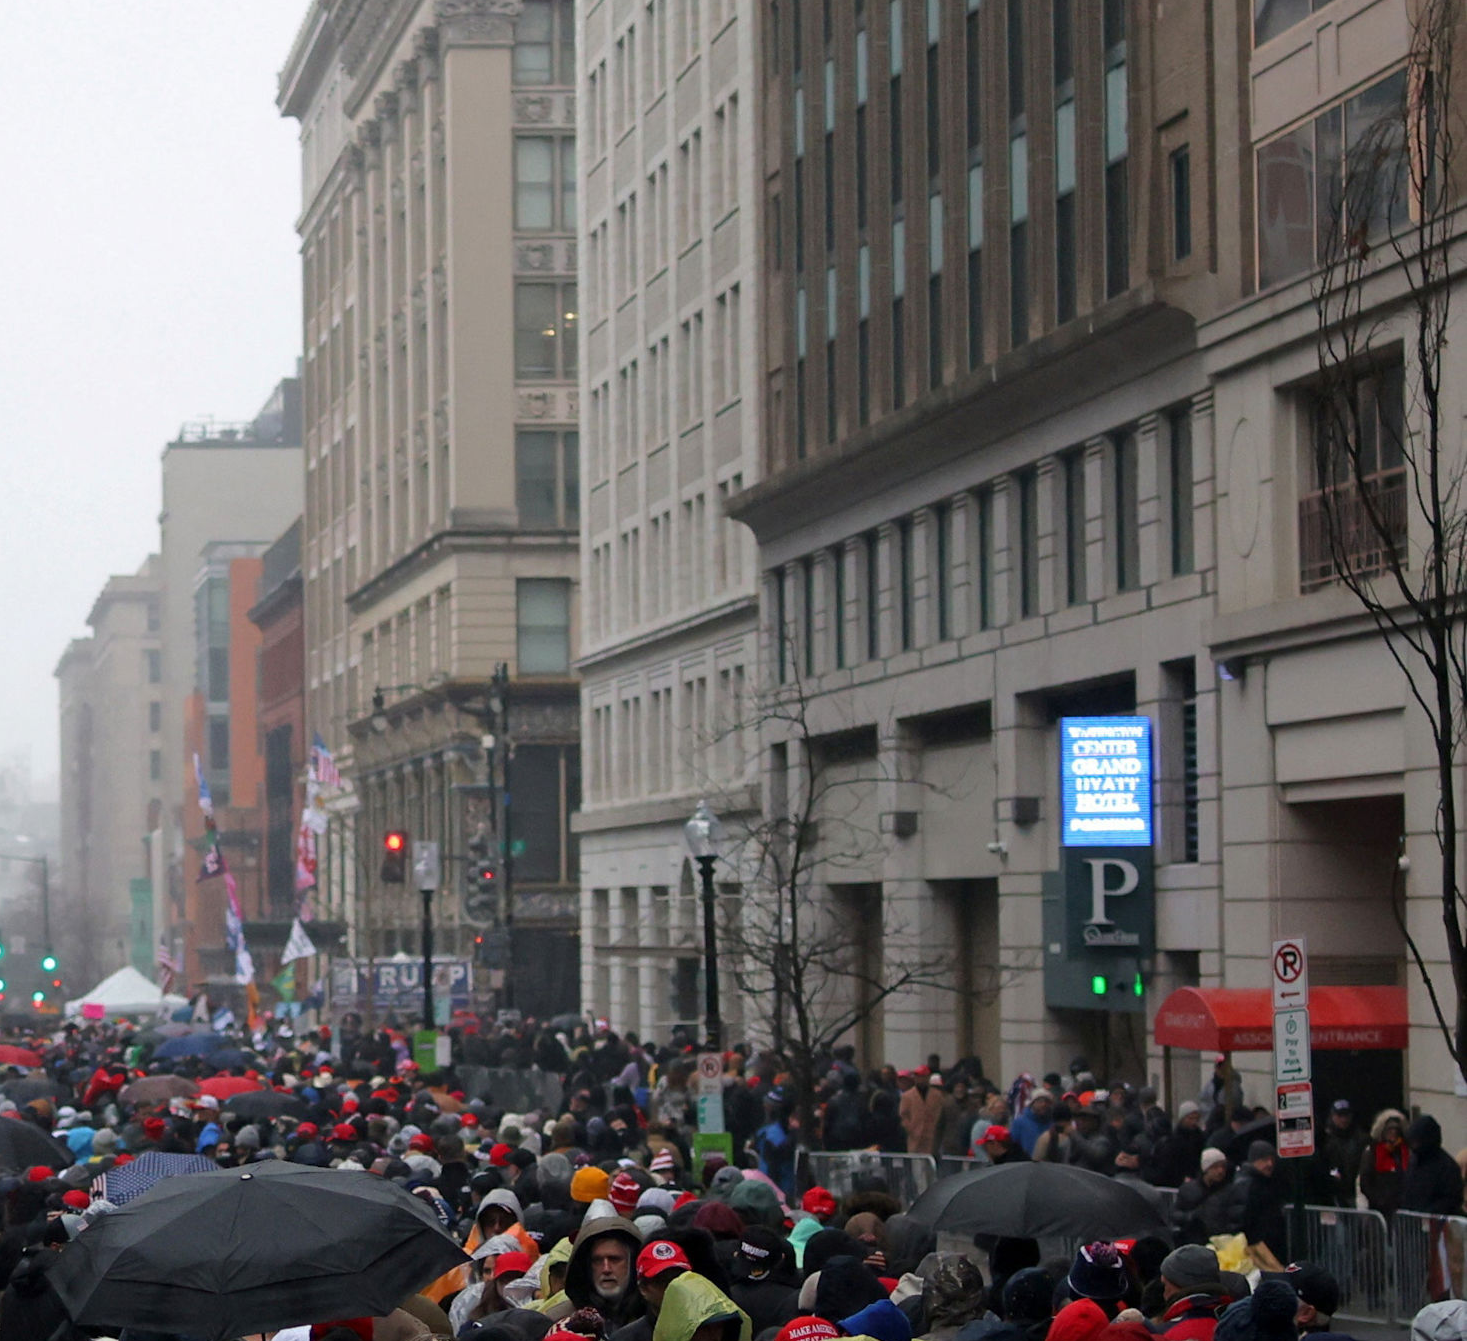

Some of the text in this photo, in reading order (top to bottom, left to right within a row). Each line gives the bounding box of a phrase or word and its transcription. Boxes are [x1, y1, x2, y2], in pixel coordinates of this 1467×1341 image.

[1073, 740, 1138, 756] CENTER
[1072, 758, 1141, 775] GRAND
[1076, 777, 1140, 791] HYATT
[1075, 793, 1140, 812] HOTEL
[1083, 859, 1139, 924] P
[741, 1241, 770, 1258] TRUMP
[789, 1325, 812, 1339] MAKE
